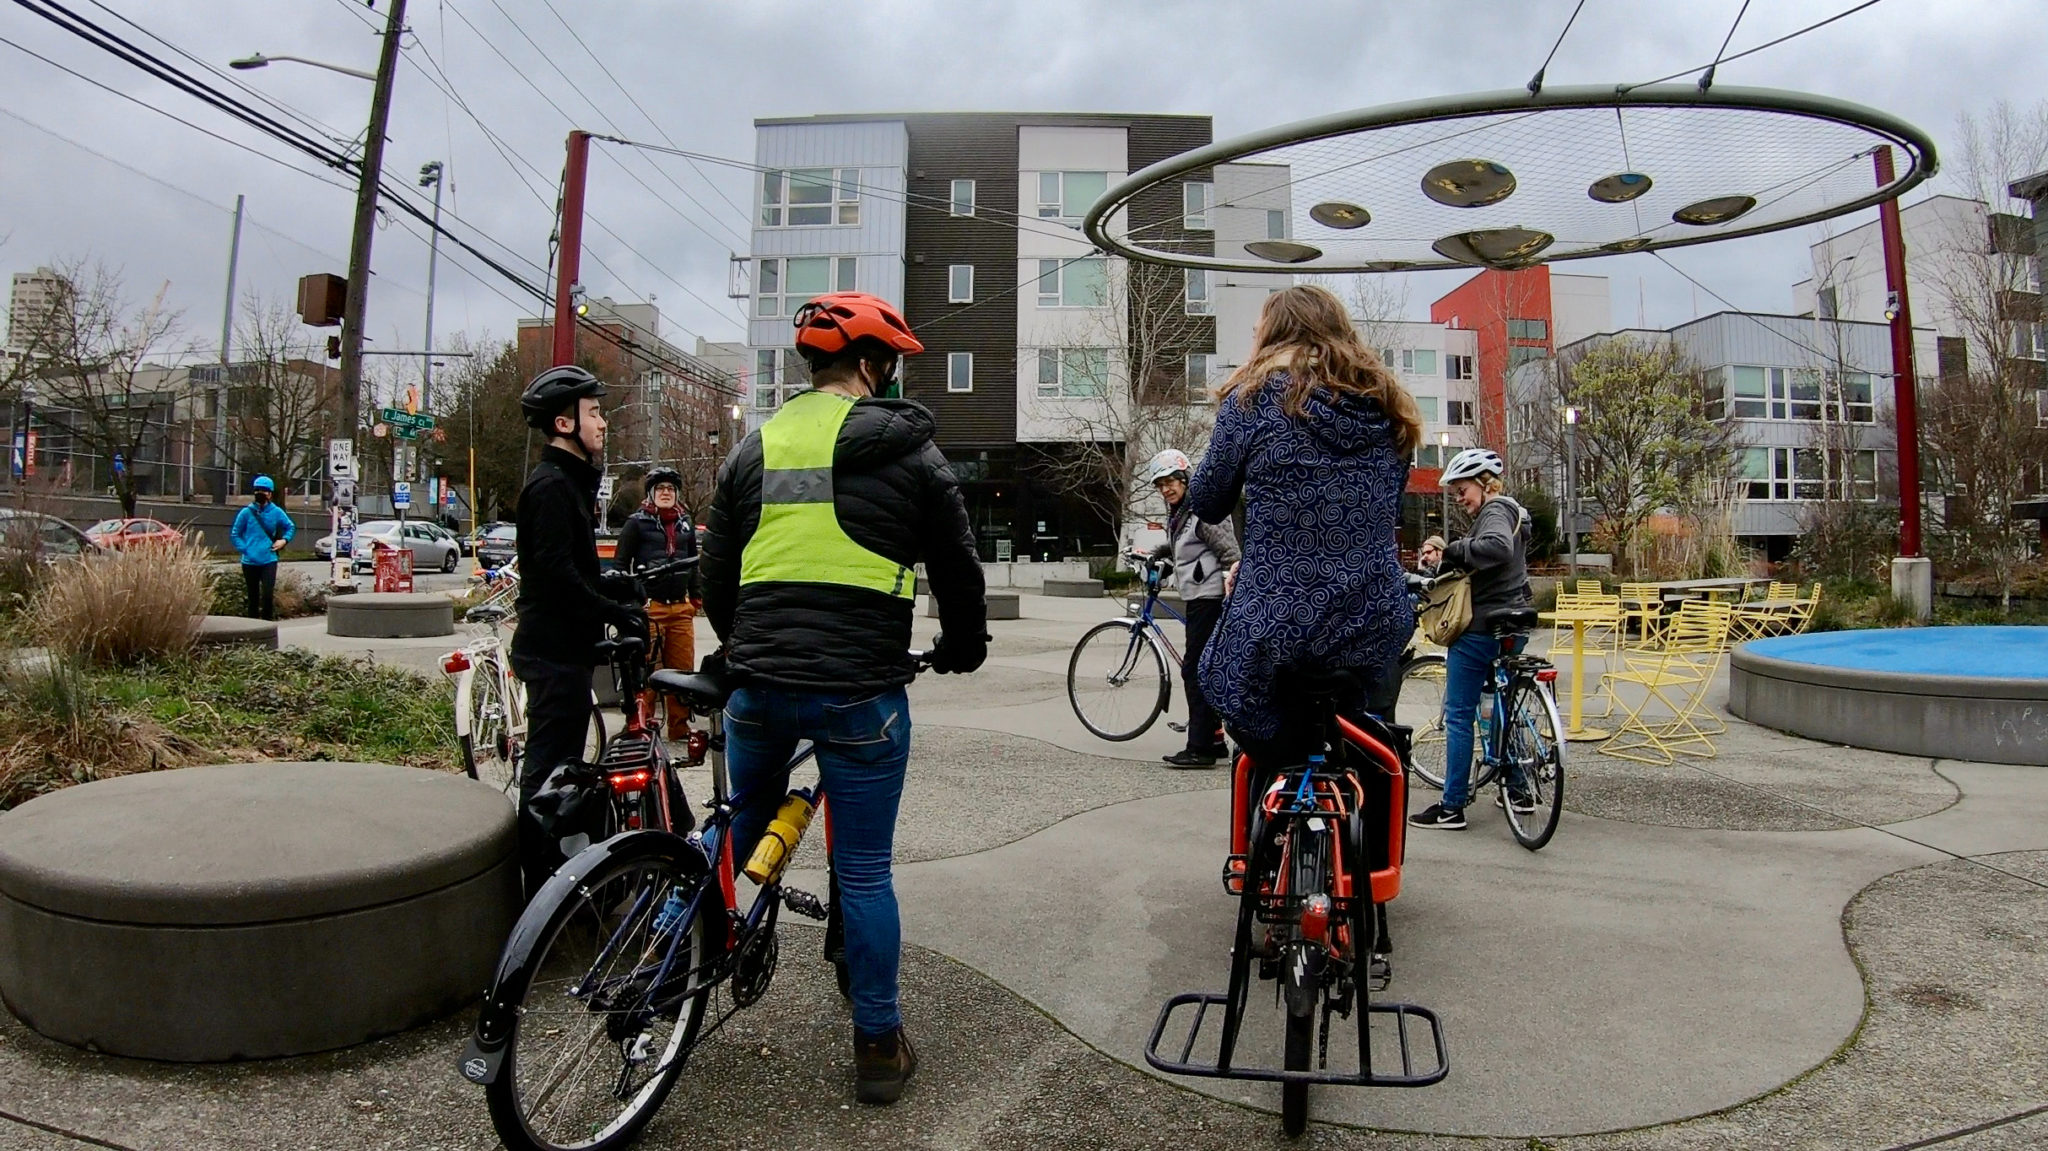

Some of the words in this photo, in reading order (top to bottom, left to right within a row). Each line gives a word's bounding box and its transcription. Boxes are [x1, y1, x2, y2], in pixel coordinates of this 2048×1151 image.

[391, 410, 416, 425] James
[333, 442, 350, 452] ONE
[332, 452, 350, 461] WAY
